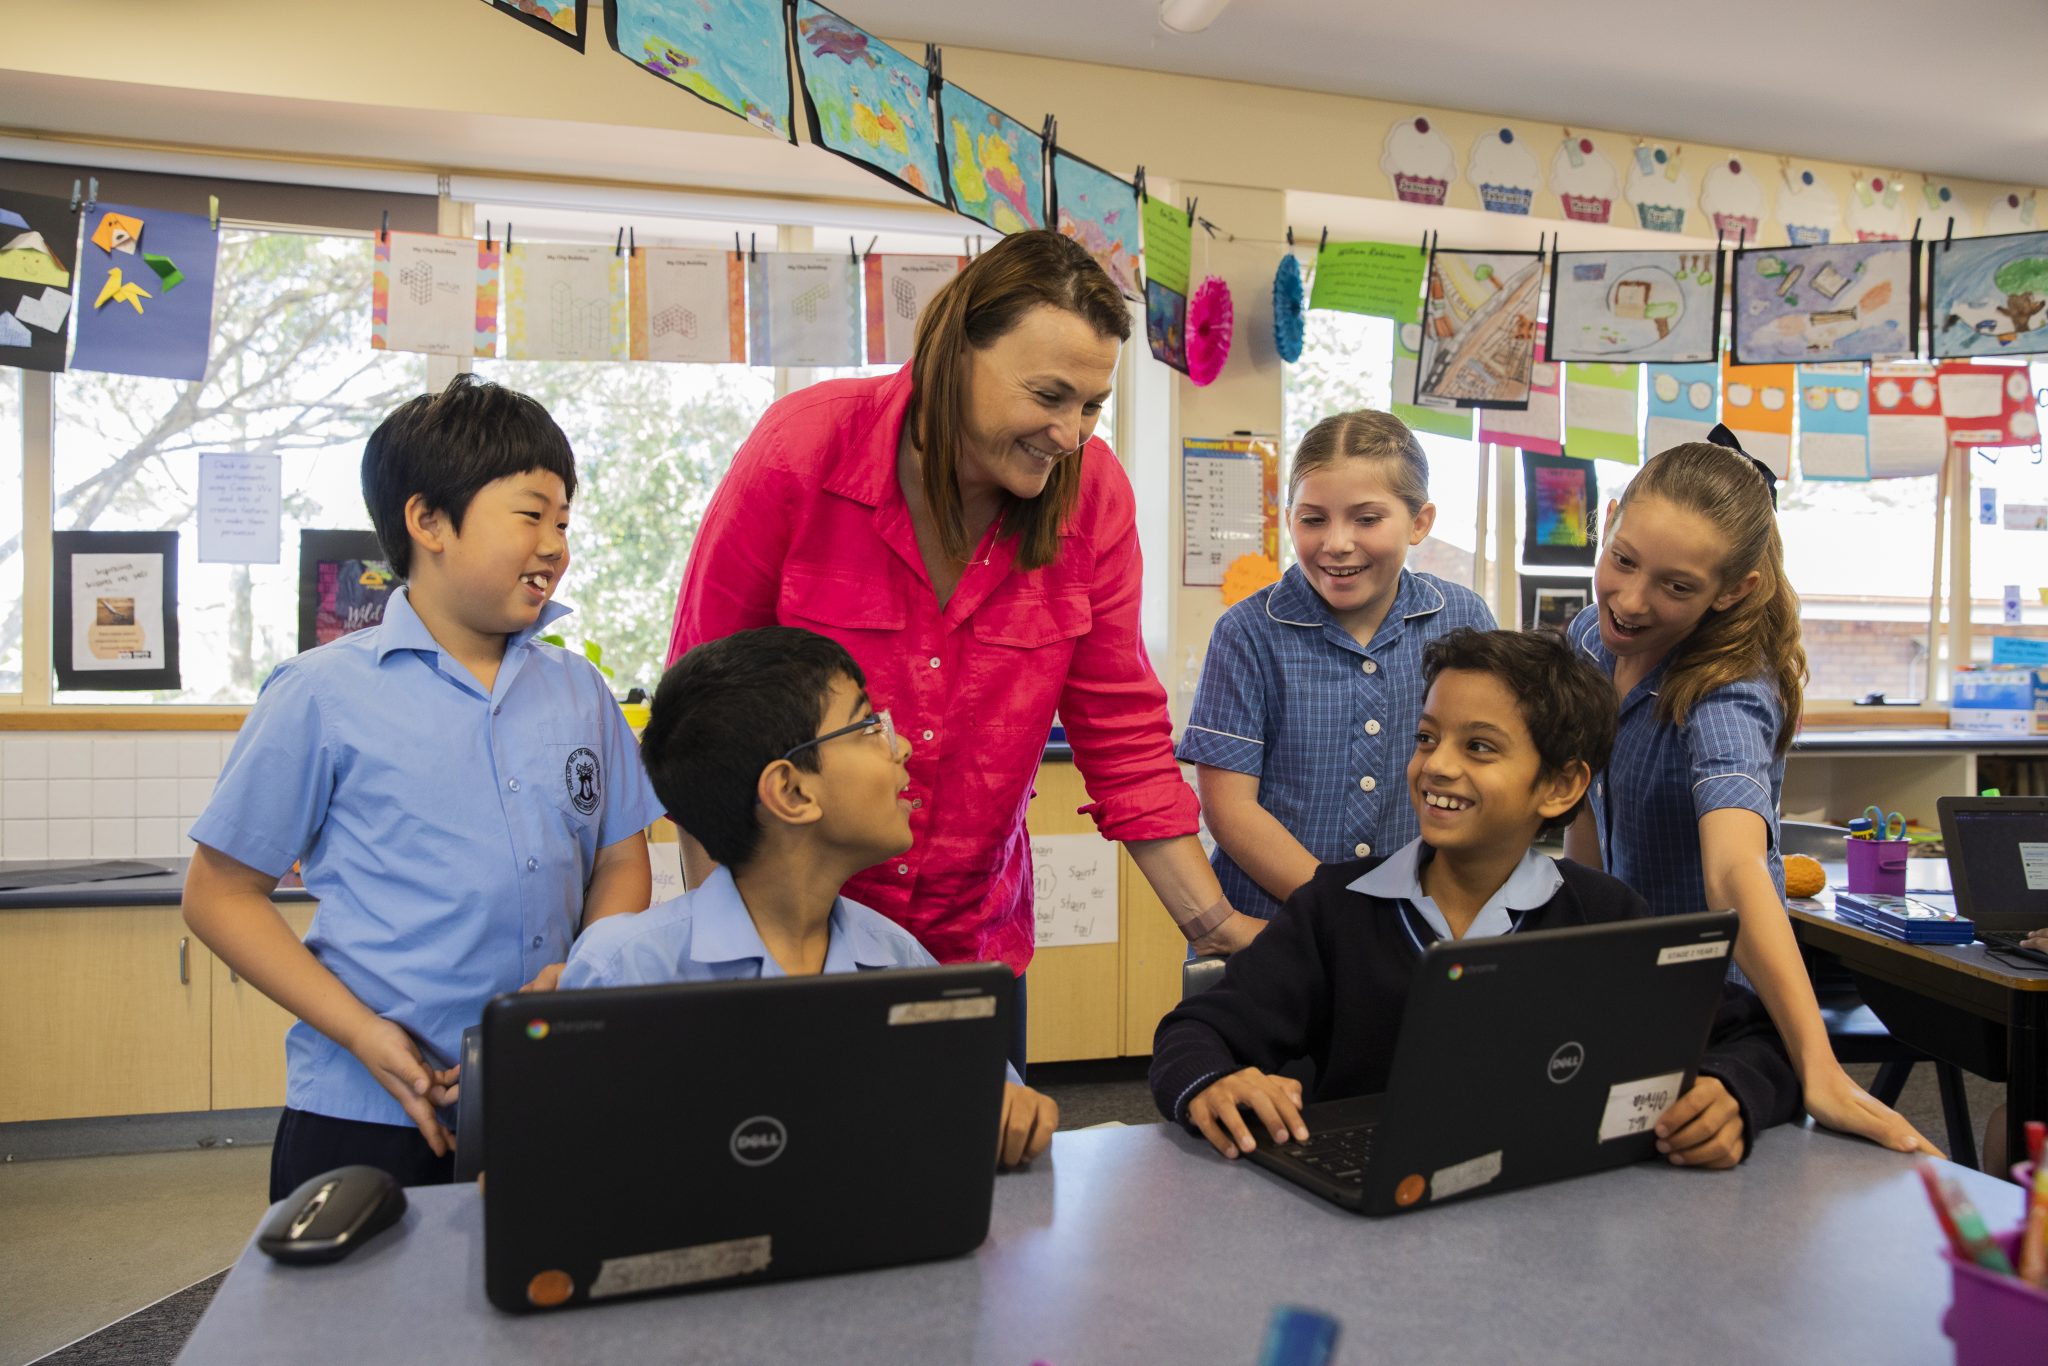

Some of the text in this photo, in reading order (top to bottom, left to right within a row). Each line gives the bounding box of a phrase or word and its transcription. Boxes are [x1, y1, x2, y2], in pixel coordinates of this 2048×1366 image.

[1401, 181, 1442, 196] January
[1552, 1055, 1579, 1069] DELL
[1632, 1090, 1668, 1111] Olivia
[737, 1133, 781, 1149] DELL
